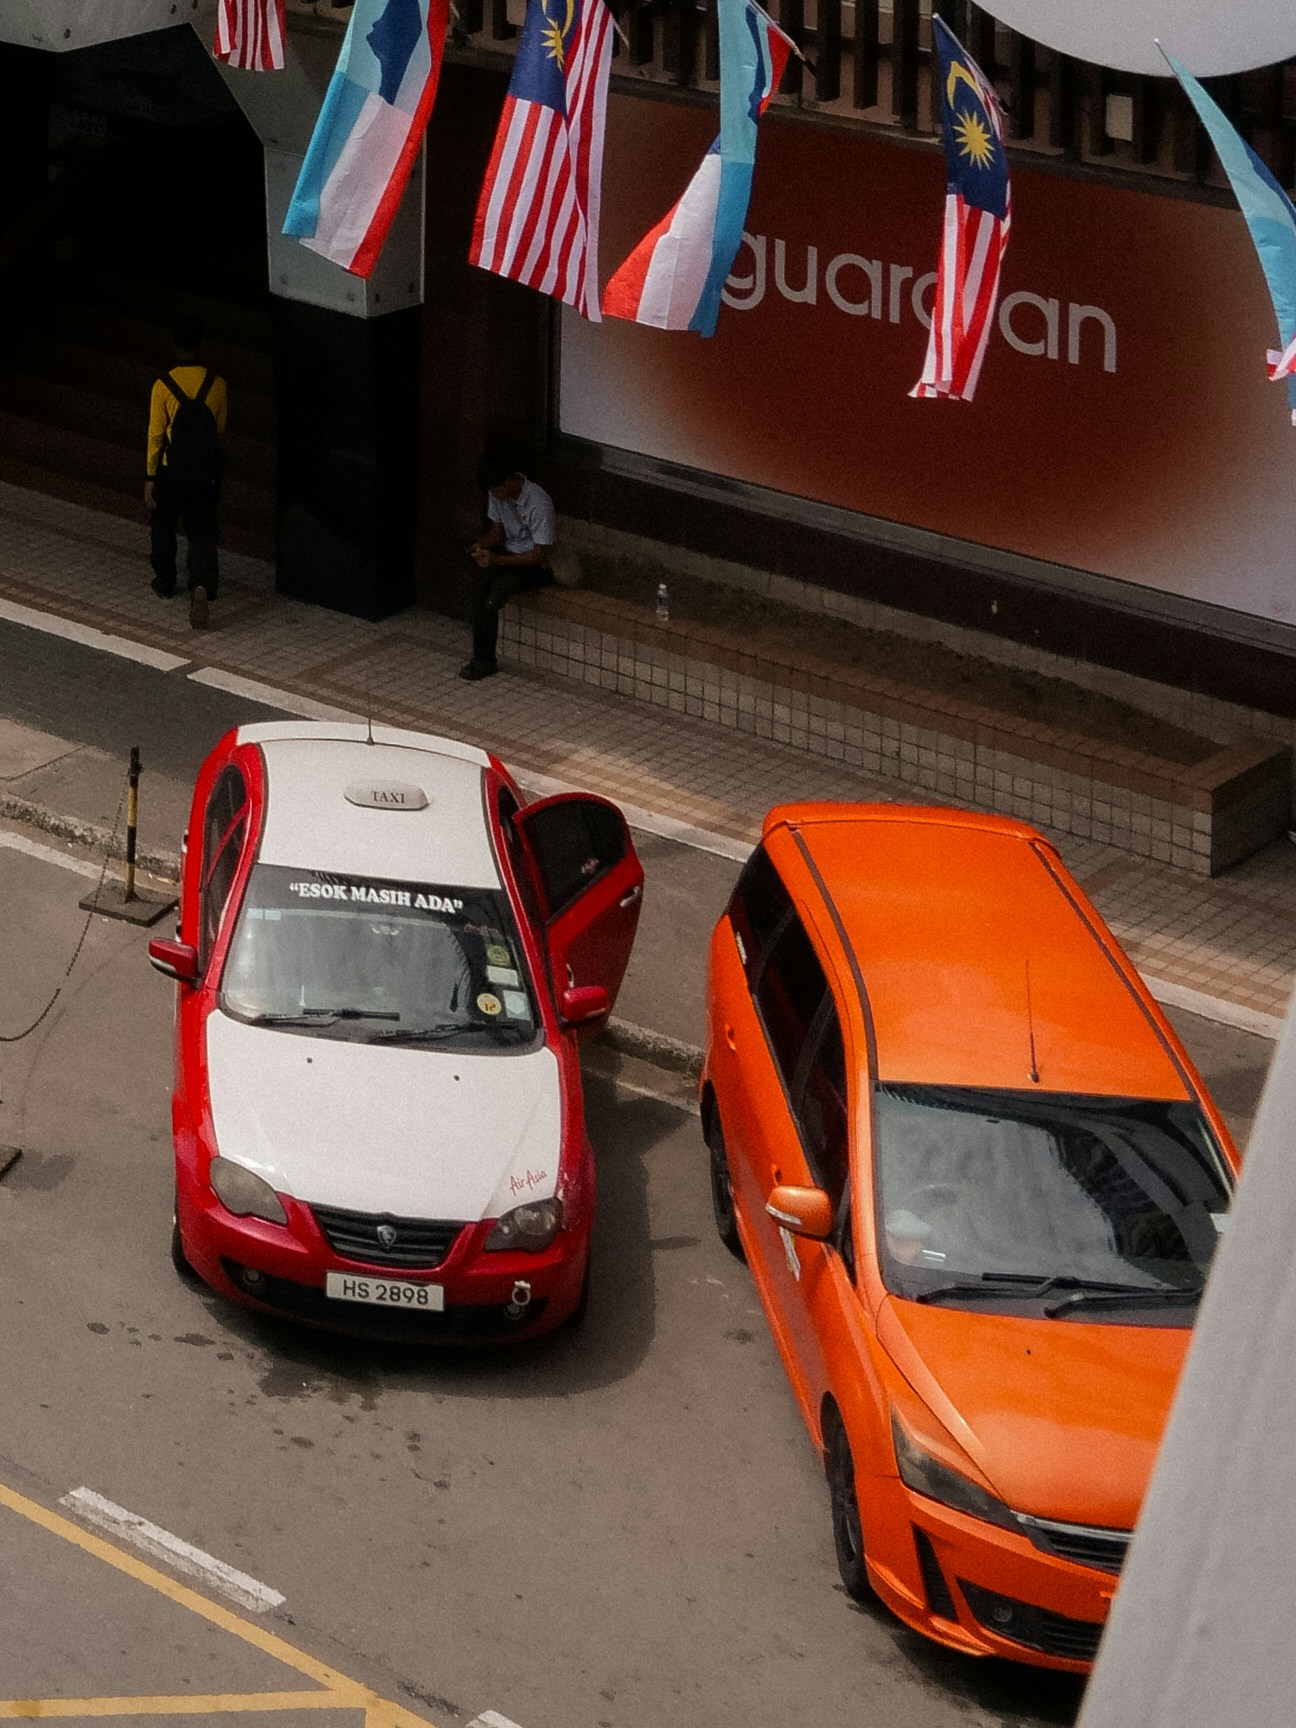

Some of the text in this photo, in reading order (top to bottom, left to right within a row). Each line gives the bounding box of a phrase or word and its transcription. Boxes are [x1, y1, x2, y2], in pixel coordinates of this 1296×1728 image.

[721, 229, 1117, 373] guaran
[370, 790, 405, 804] TAXI
[351, 887, 411, 906] MASIH
[343, 1279, 428, 1305] HS 2898
